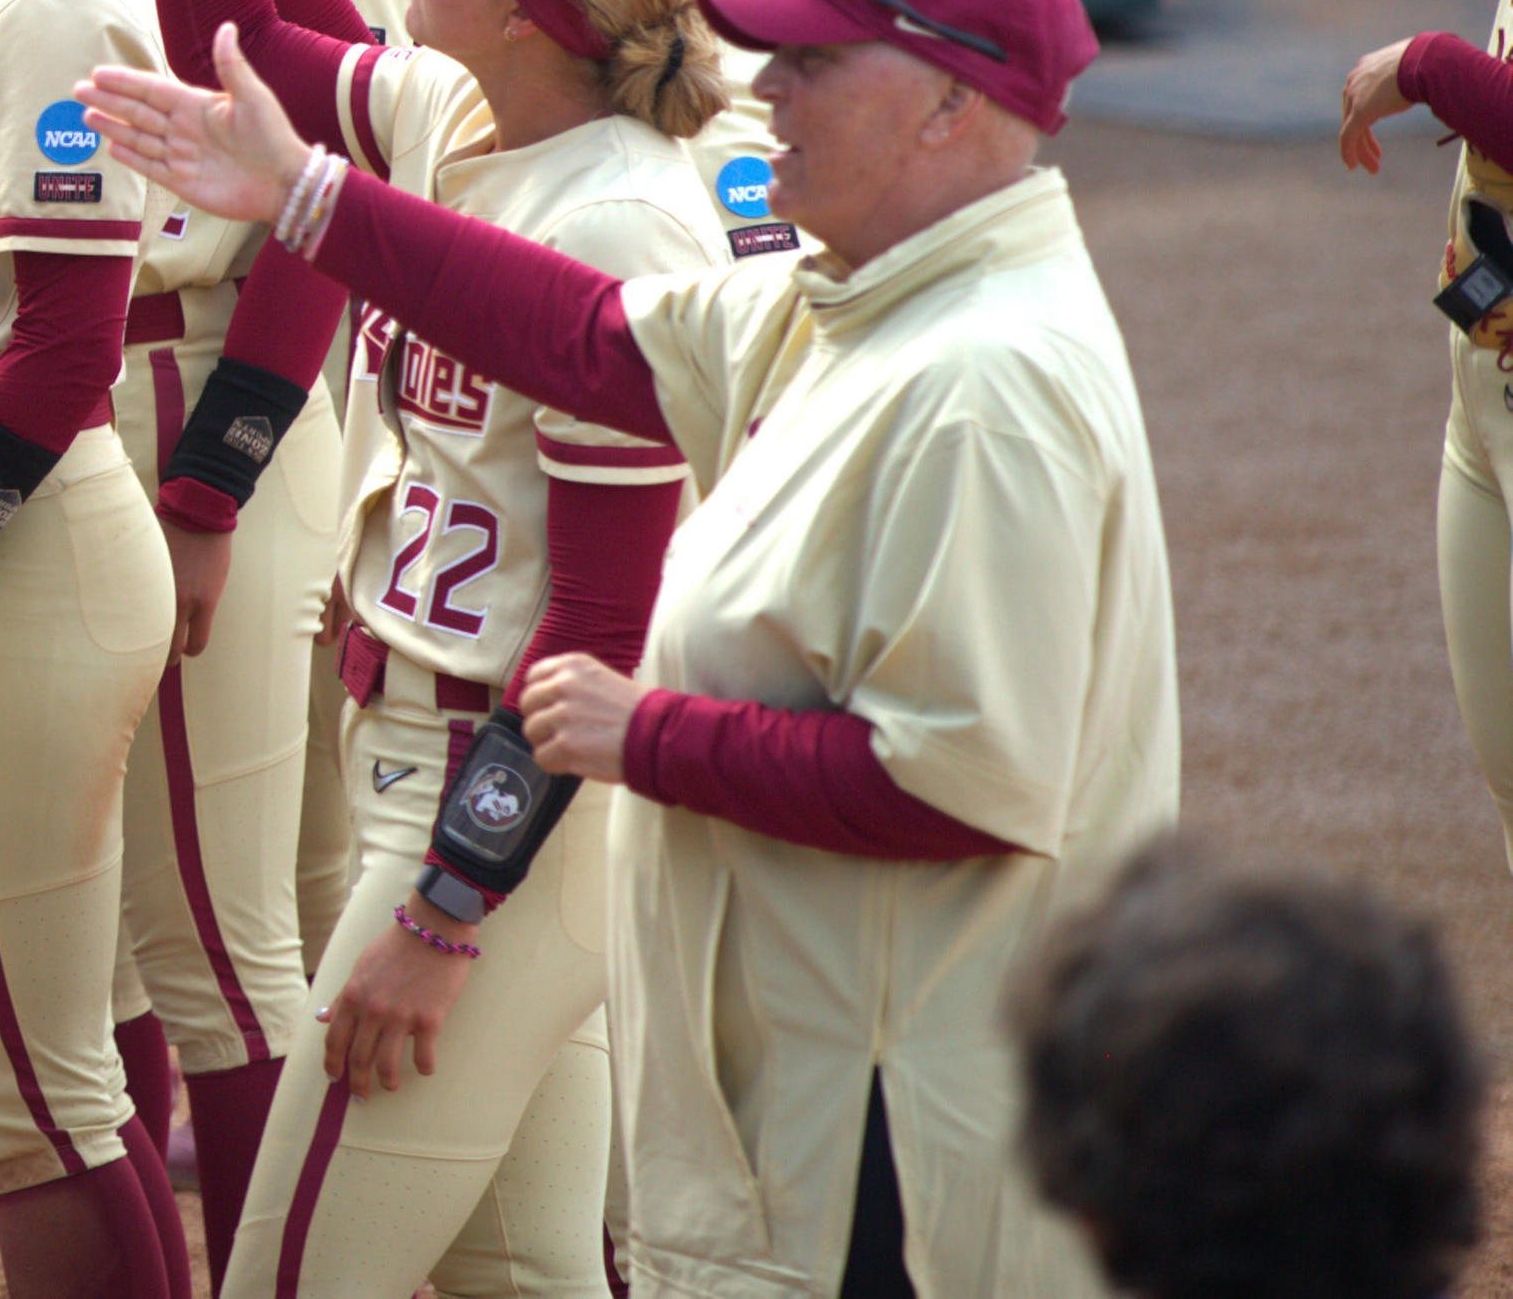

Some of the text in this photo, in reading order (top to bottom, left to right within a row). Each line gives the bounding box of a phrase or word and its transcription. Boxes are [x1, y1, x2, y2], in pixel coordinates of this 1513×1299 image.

[45, 131, 96, 148] NCAA
[38, 175, 96, 201] UNITE
[733, 225, 794, 255] UNITE
[376, 481, 499, 639] 22
